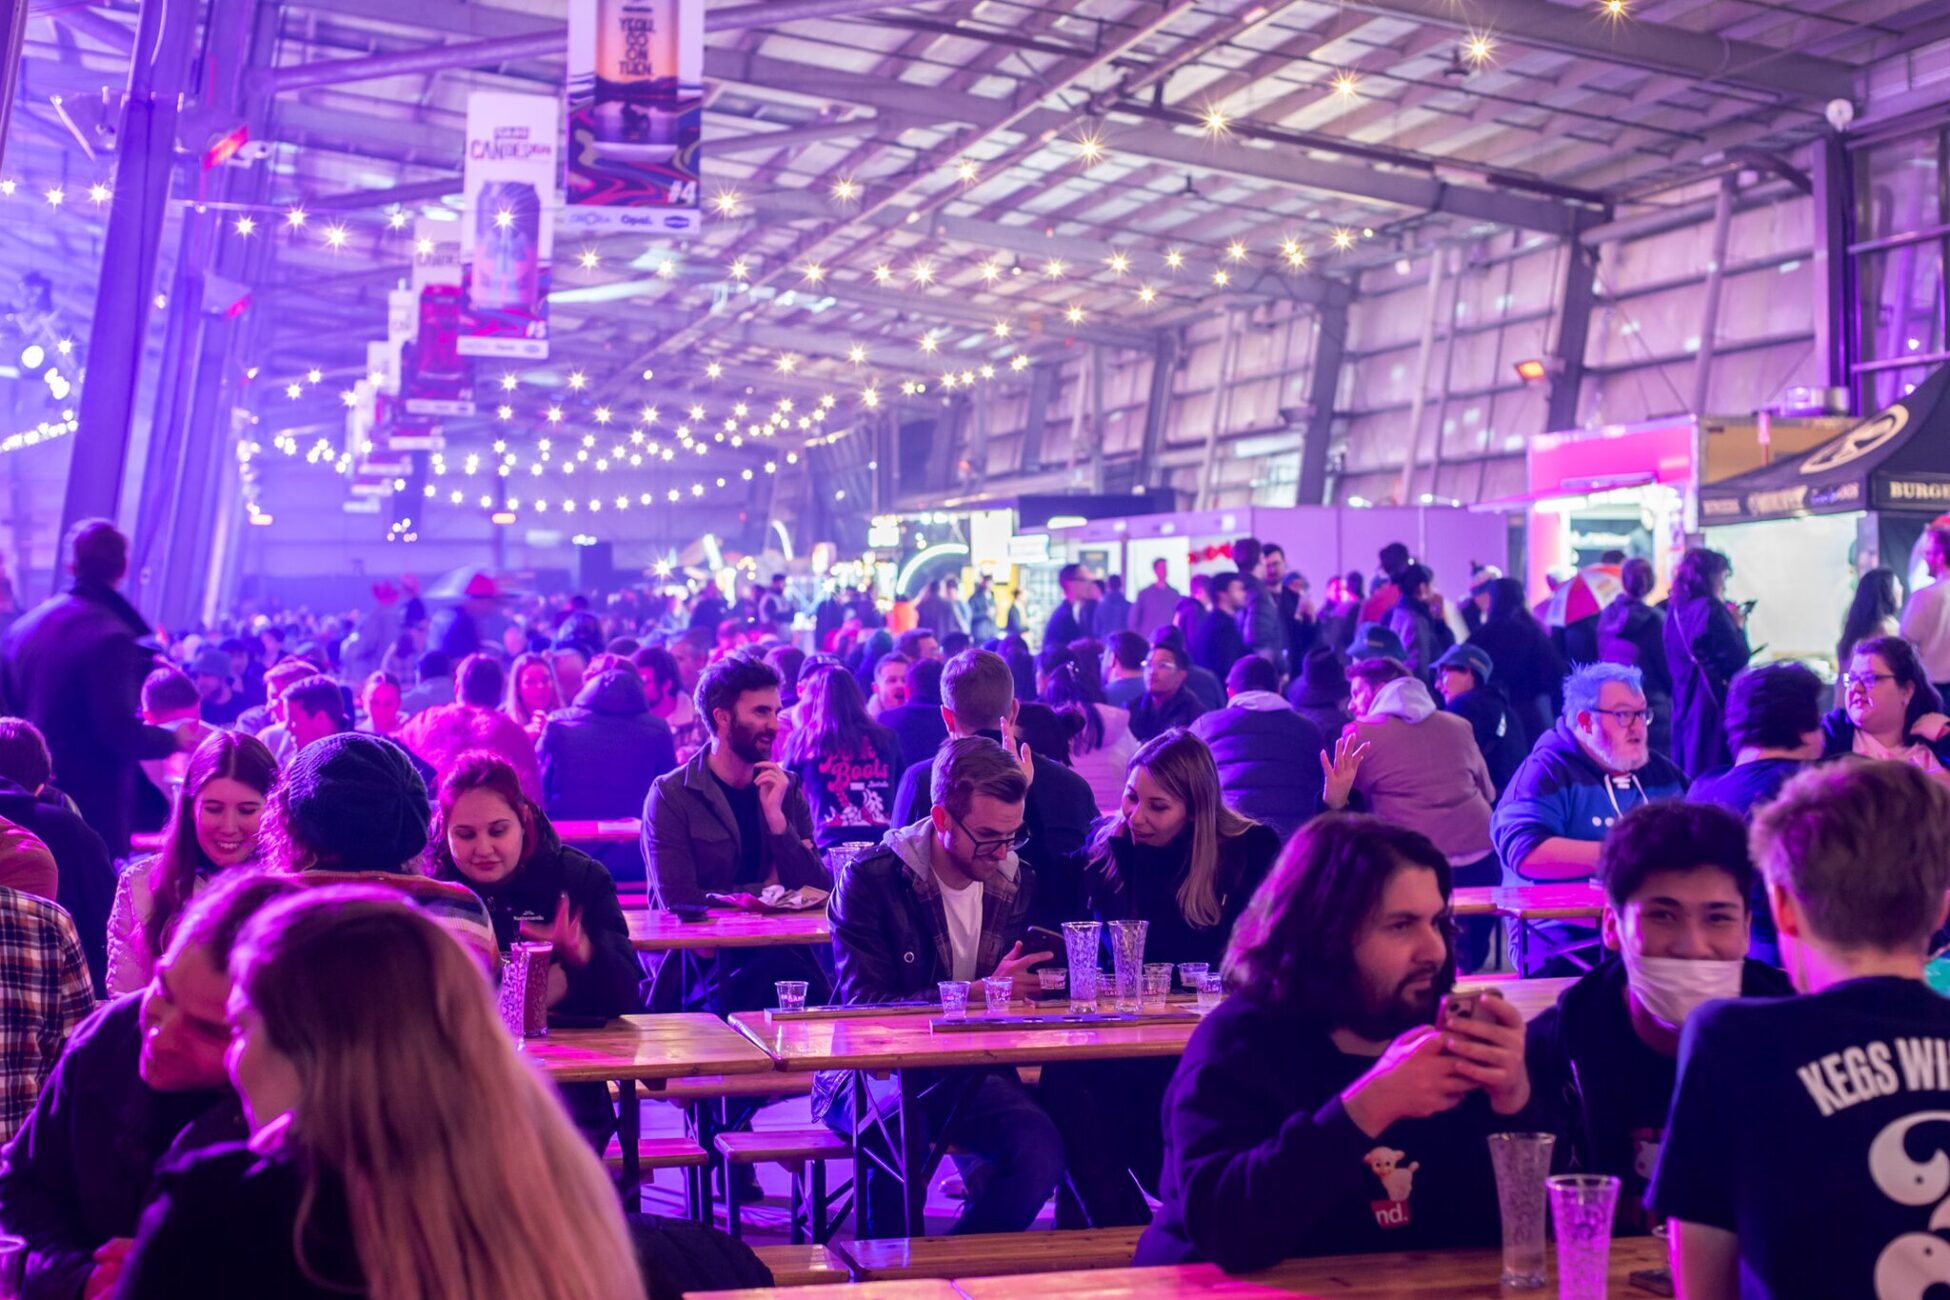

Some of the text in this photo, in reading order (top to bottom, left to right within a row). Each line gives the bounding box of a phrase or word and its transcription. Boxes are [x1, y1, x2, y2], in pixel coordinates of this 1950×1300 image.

[668, 180, 697, 204] #4
[1796, 1037, 1950, 1117] KEGS WI
